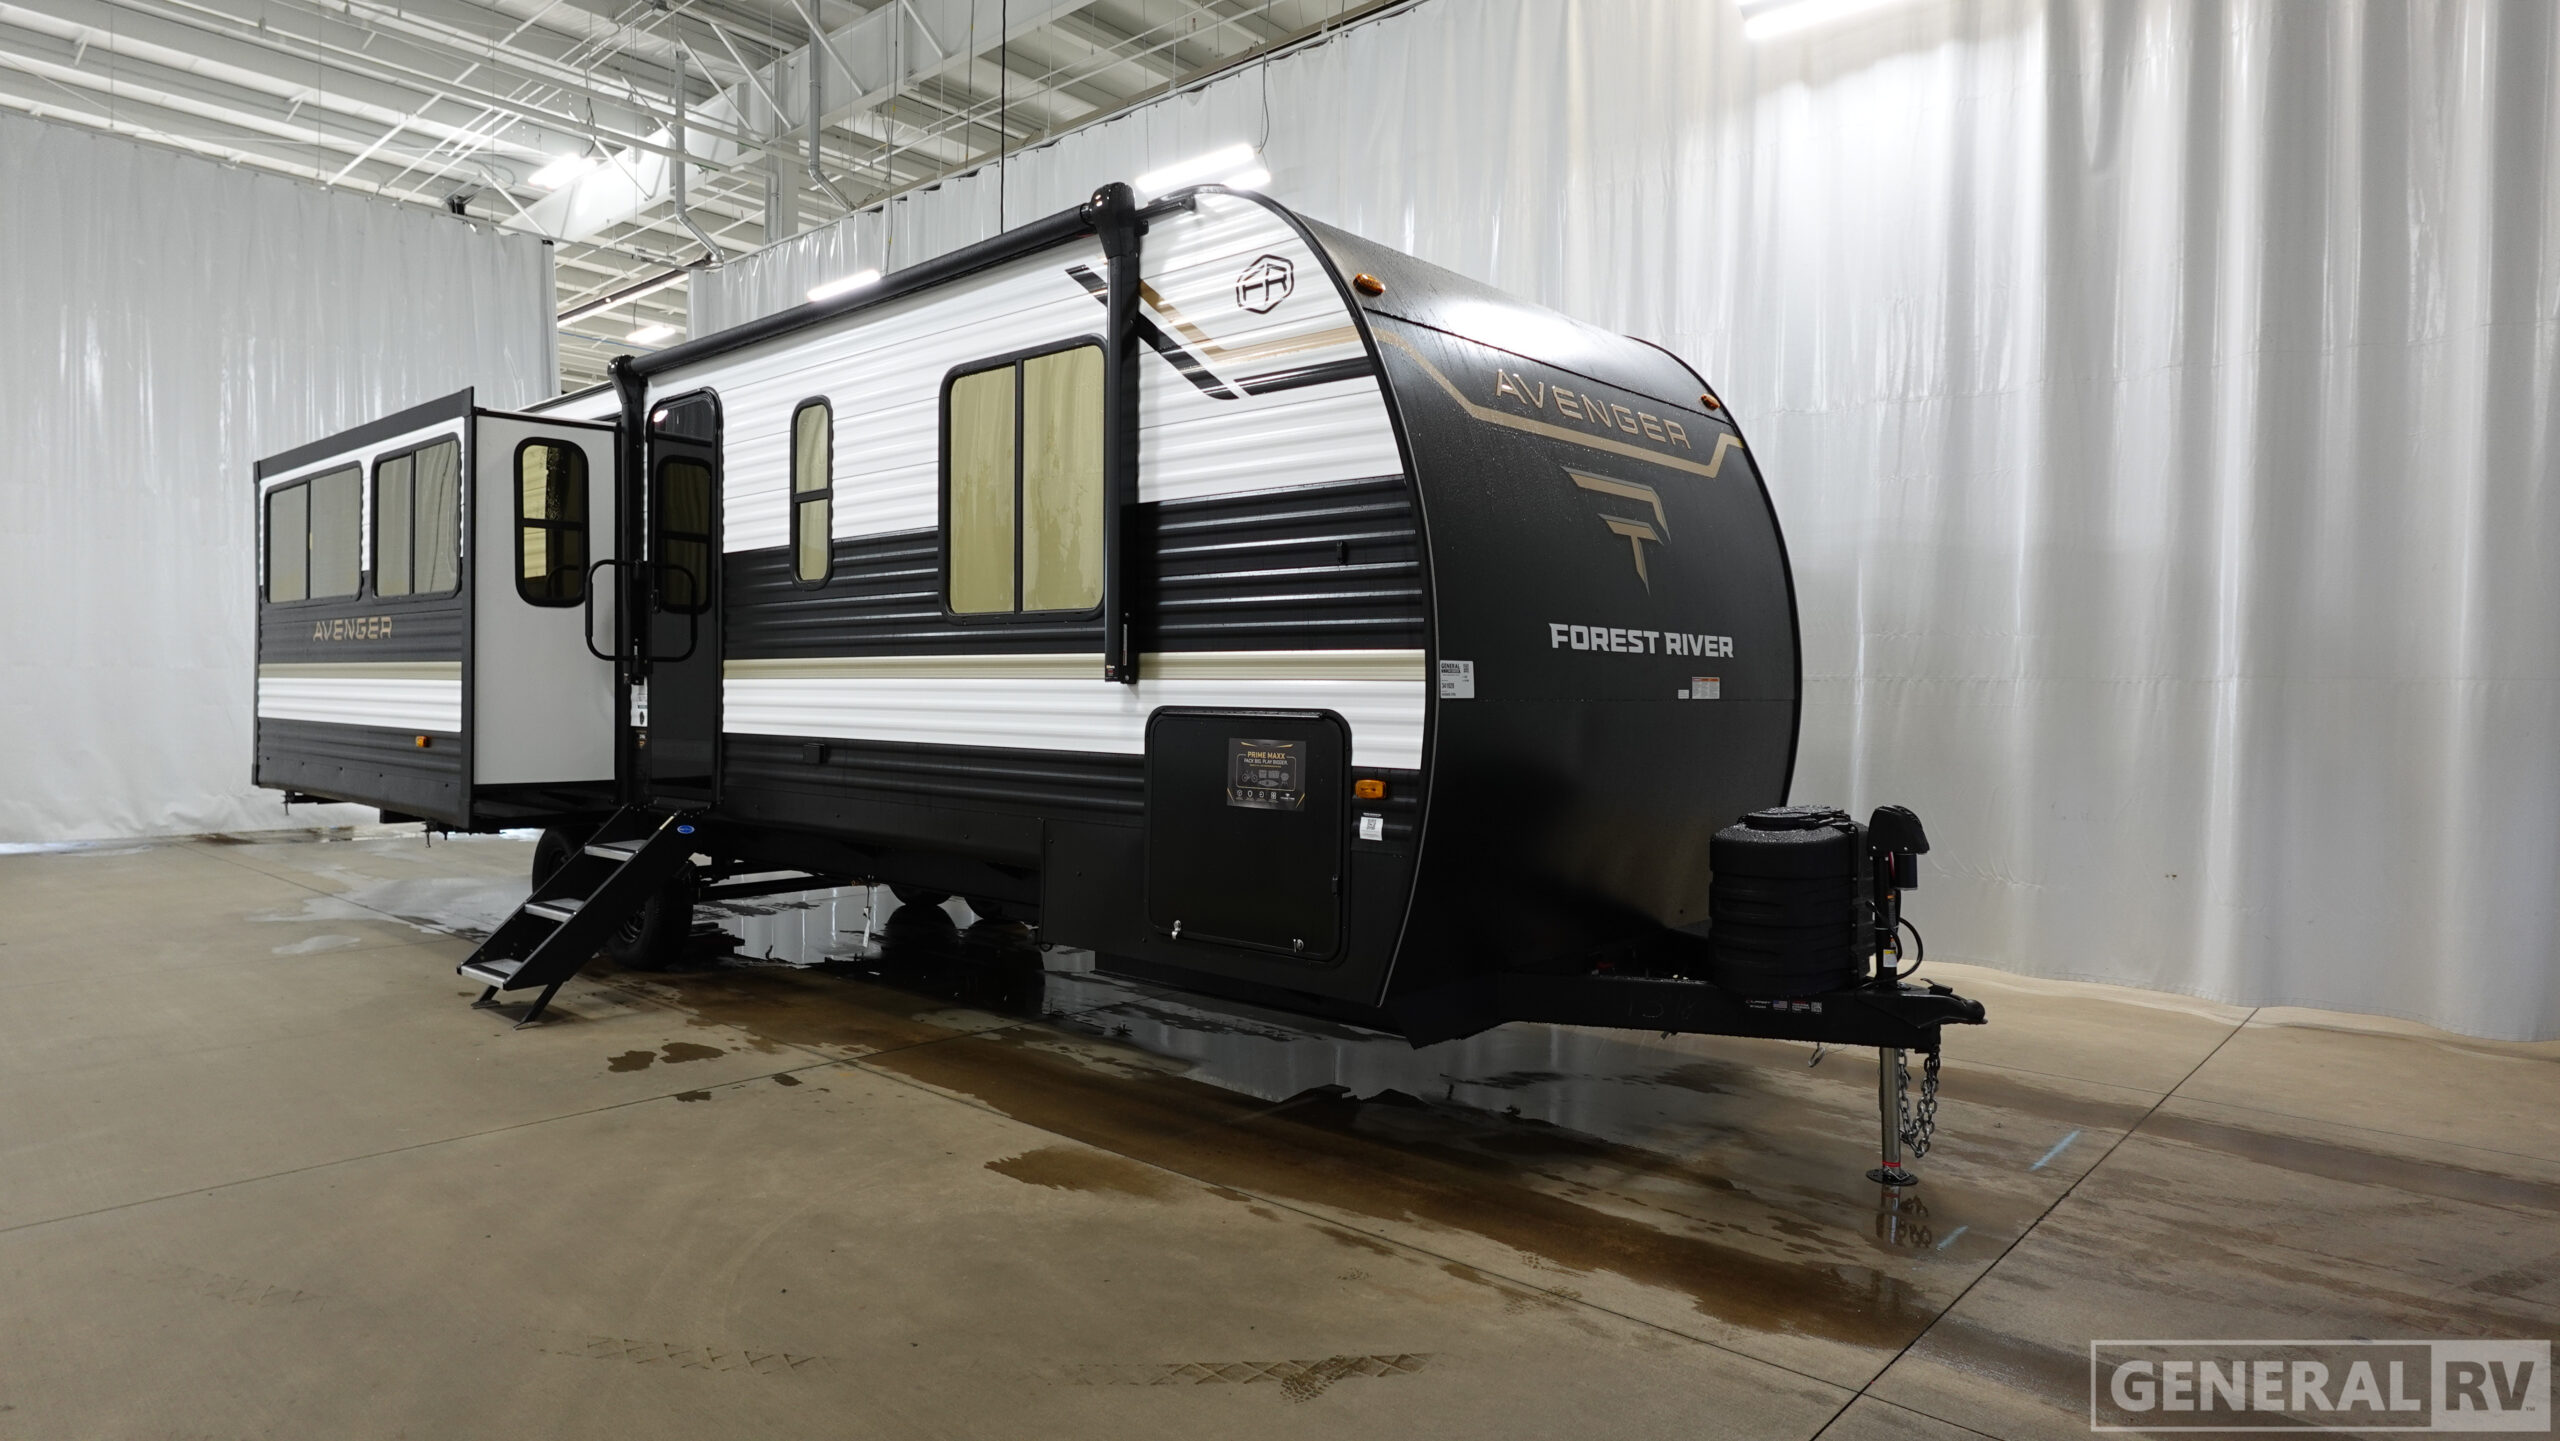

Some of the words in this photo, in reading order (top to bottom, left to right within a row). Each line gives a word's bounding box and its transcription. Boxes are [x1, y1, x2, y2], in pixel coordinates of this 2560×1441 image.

[1496, 368, 1691, 450] AVENGER
[312, 615, 392, 642] AVENGER
[1548, 623, 1660, 655] FOREST
[1663, 631, 1734, 659] RIVER
[1247, 751, 1267, 759] PRIME
[1267, 752, 1286, 760] MAXX
